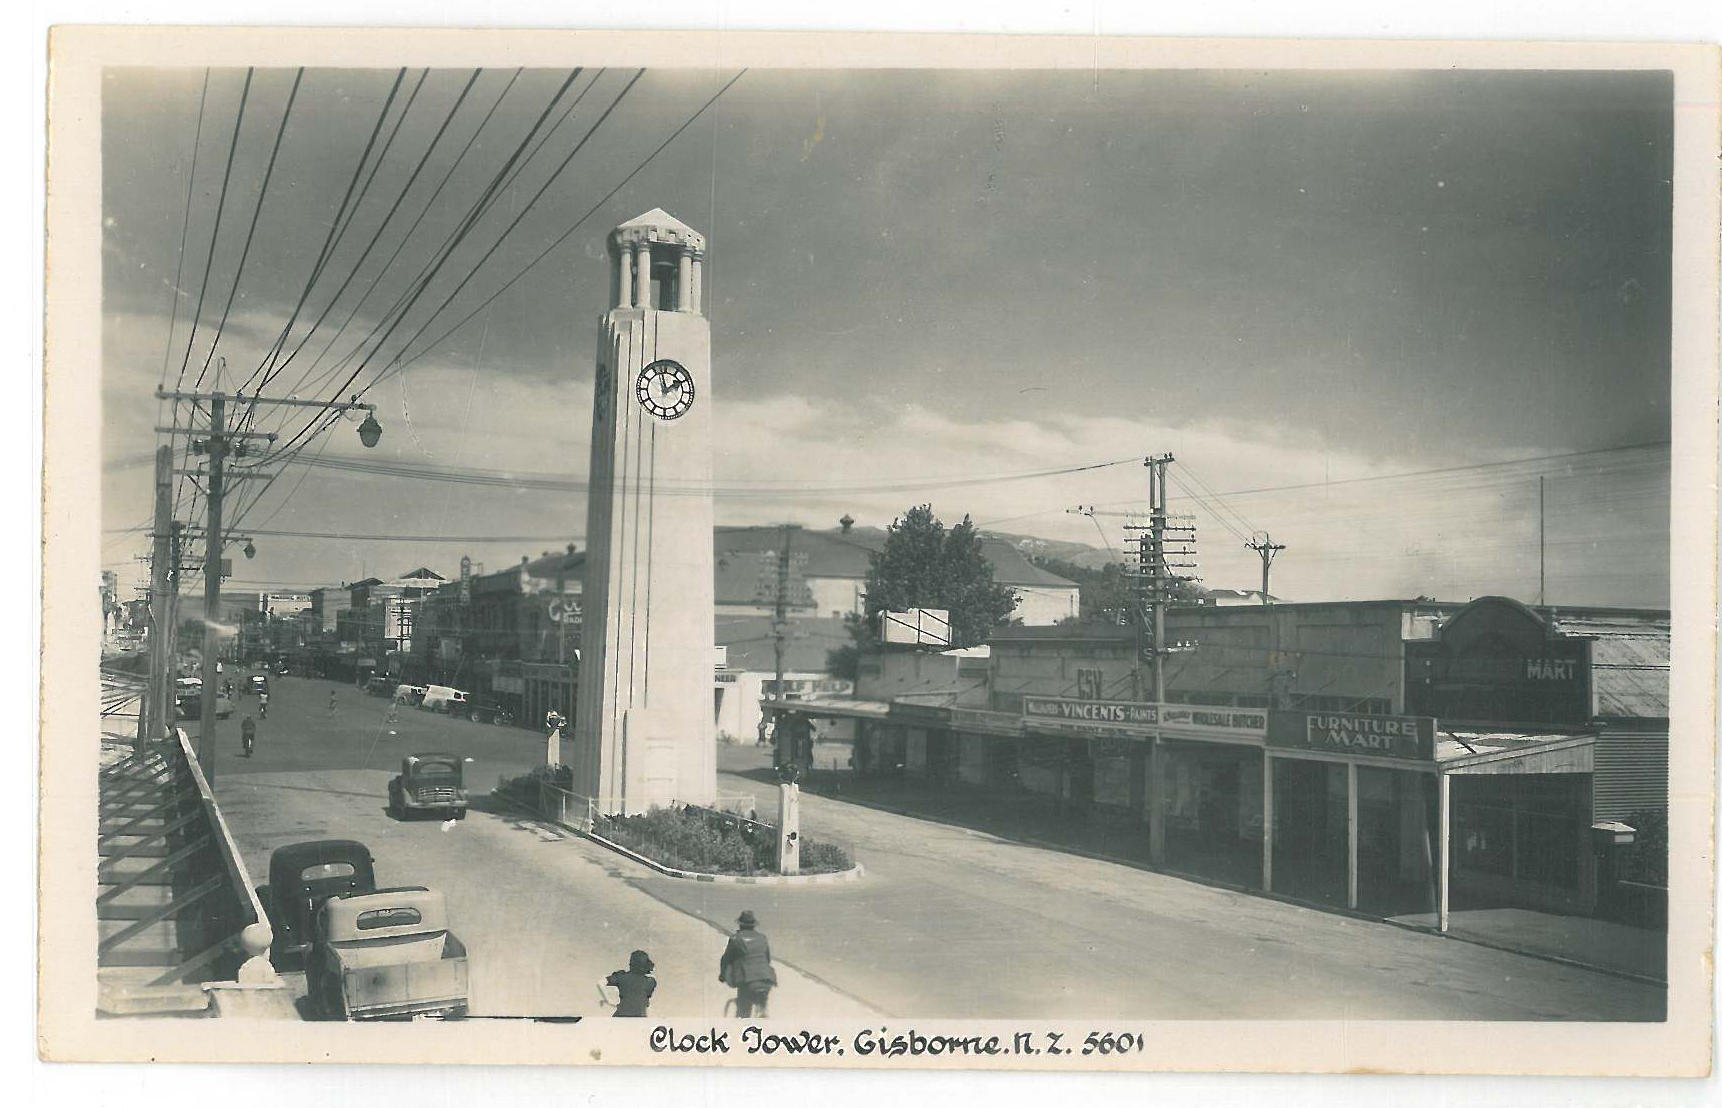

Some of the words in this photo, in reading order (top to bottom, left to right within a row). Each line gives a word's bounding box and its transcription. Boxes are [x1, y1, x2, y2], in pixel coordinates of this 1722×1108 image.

[1526, 658, 1577, 680] MART
[1062, 702, 1125, 721] VINCENTS
[1306, 715, 1419, 742] FURNITURE
[1325, 730, 1404, 749] MART
